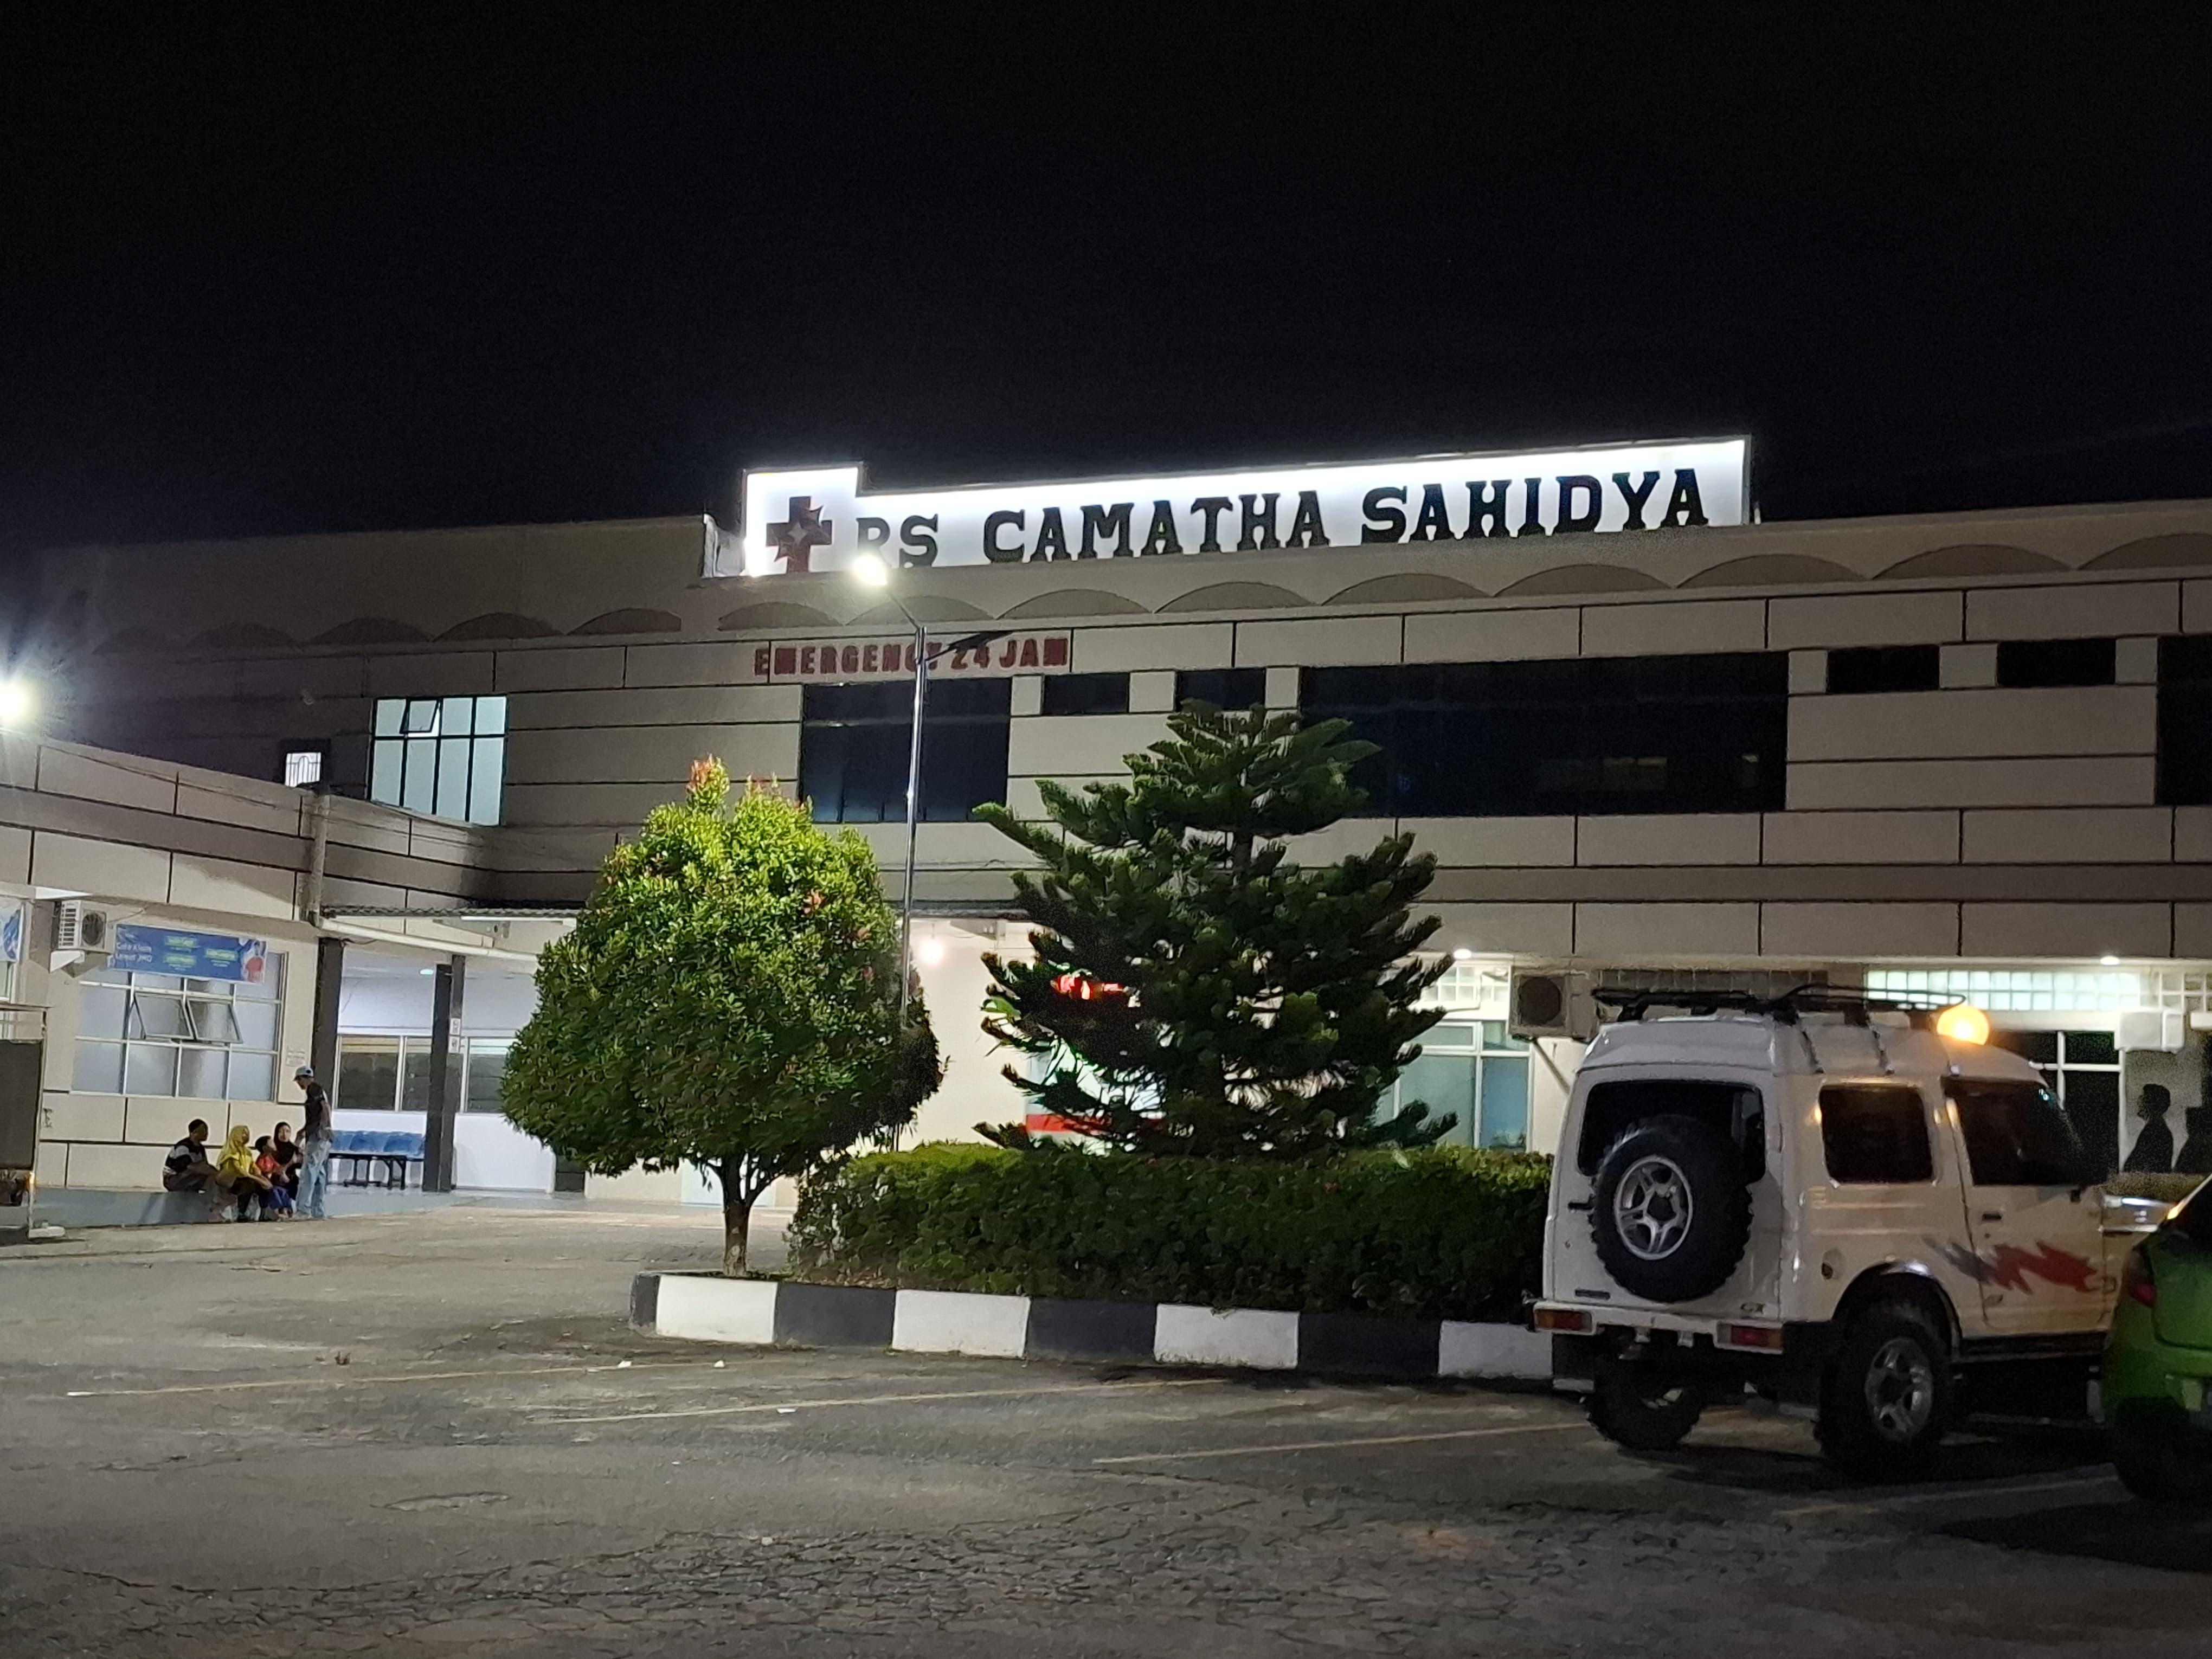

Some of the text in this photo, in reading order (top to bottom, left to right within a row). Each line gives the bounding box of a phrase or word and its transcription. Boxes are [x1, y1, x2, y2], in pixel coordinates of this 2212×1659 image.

[856, 468, 1709, 568] RS CAMATHA SAHIDYA
[951, 644, 990, 670] 24
